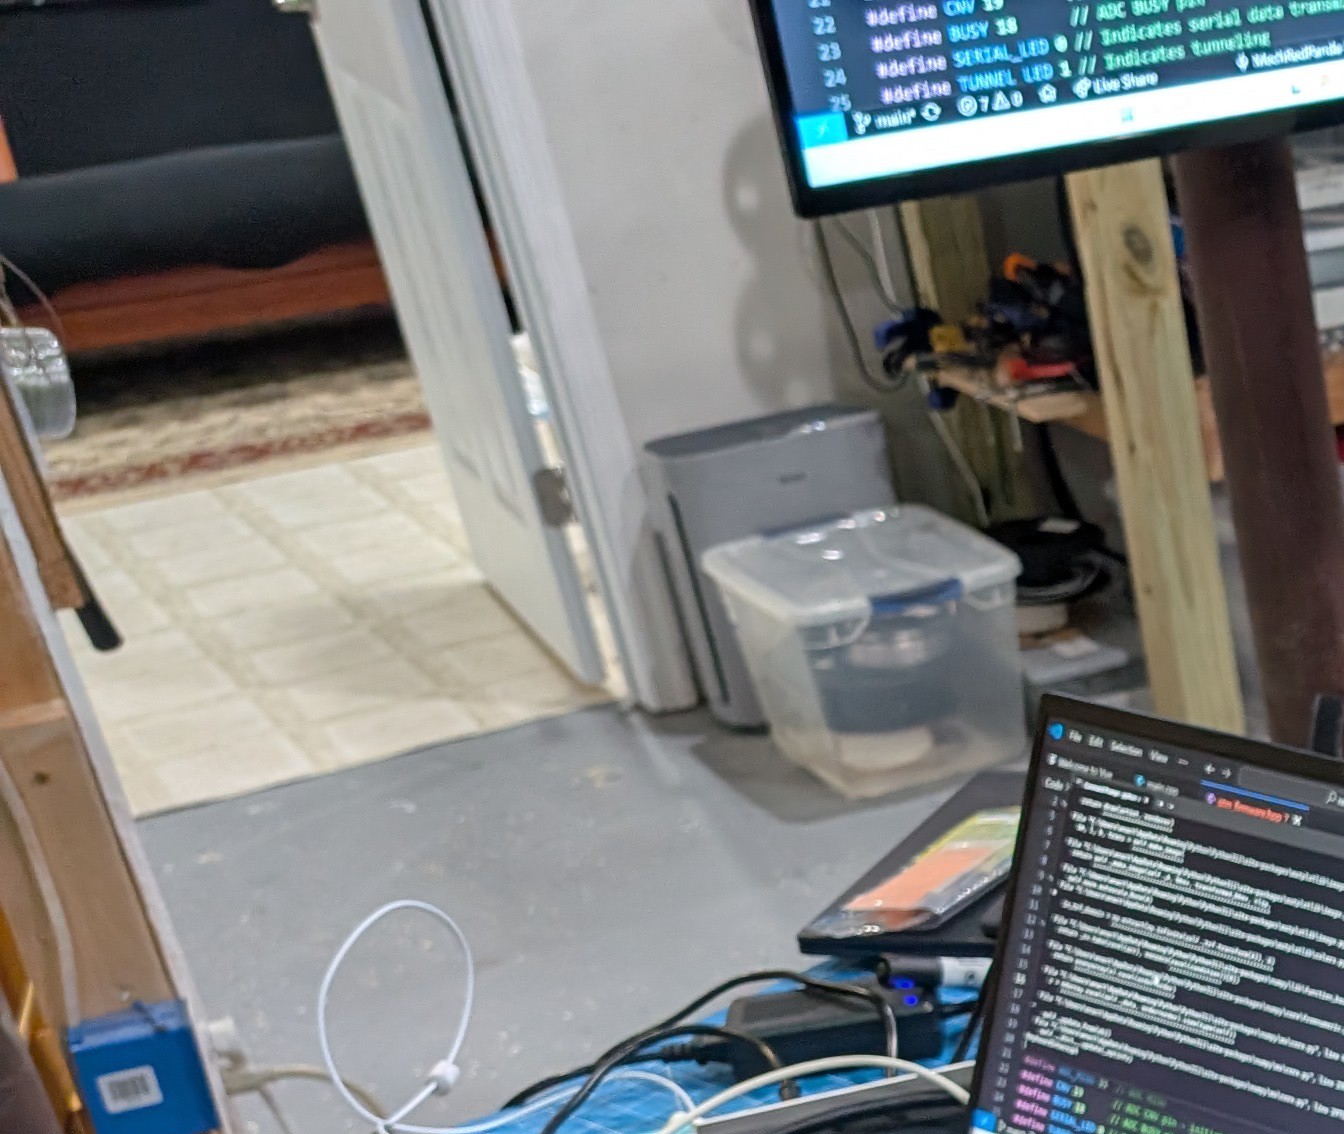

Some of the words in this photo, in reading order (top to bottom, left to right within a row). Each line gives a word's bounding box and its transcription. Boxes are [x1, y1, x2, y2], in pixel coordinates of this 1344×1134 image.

[812, 16, 836, 35] 22
[865, 4, 938, 27] #define
[817, 42, 841, 62] 23
[870, 29, 942, 52] #define
[948, 20, 989, 42] BUSY
[1096, 1, 1126, 21] ADC
[823, 68, 847, 88] 24
[875, 53, 947, 79] #define
[952, 38, 1049, 66] SERIAL_LED
[1100, 20, 1182, 46] Indicates
[1188, 8, 1241, 32] serial
[1247, 5, 1284, 23] data
[880, 79, 951, 104] #define
[1104, 46, 1185, 71] Indicates
[1191, 31, 1271, 56] tunneling
[1093, 77, 1120, 94] Live
[1121, 72, 1158, 90] Share
